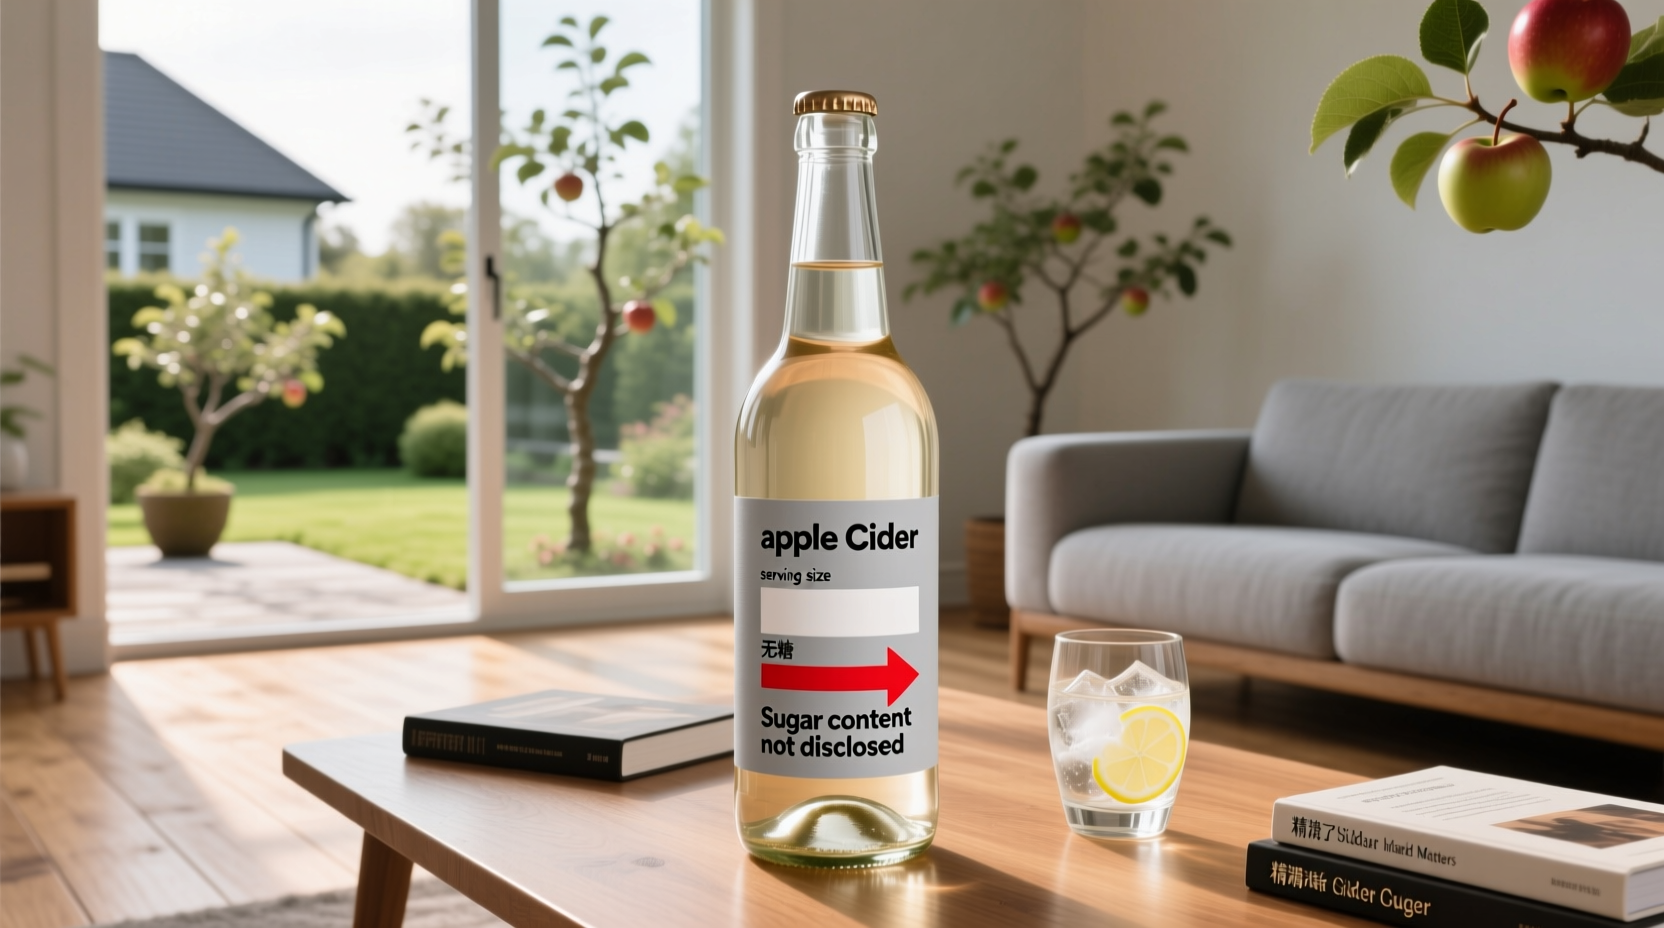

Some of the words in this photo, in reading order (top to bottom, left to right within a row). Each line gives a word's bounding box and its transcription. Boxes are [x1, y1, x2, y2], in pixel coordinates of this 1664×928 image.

[761, 523, 838, 557] apple
[845, 522, 919, 551] Cider
[760, 568, 801, 585] serving
[806, 568, 831, 582] size
[761, 639, 794, 660] 无糖
[761, 706, 823, 735] Sugar
[827, 708, 912, 730] content
[761, 736, 795, 756] not
[800, 733, 904, 758] disclosed
